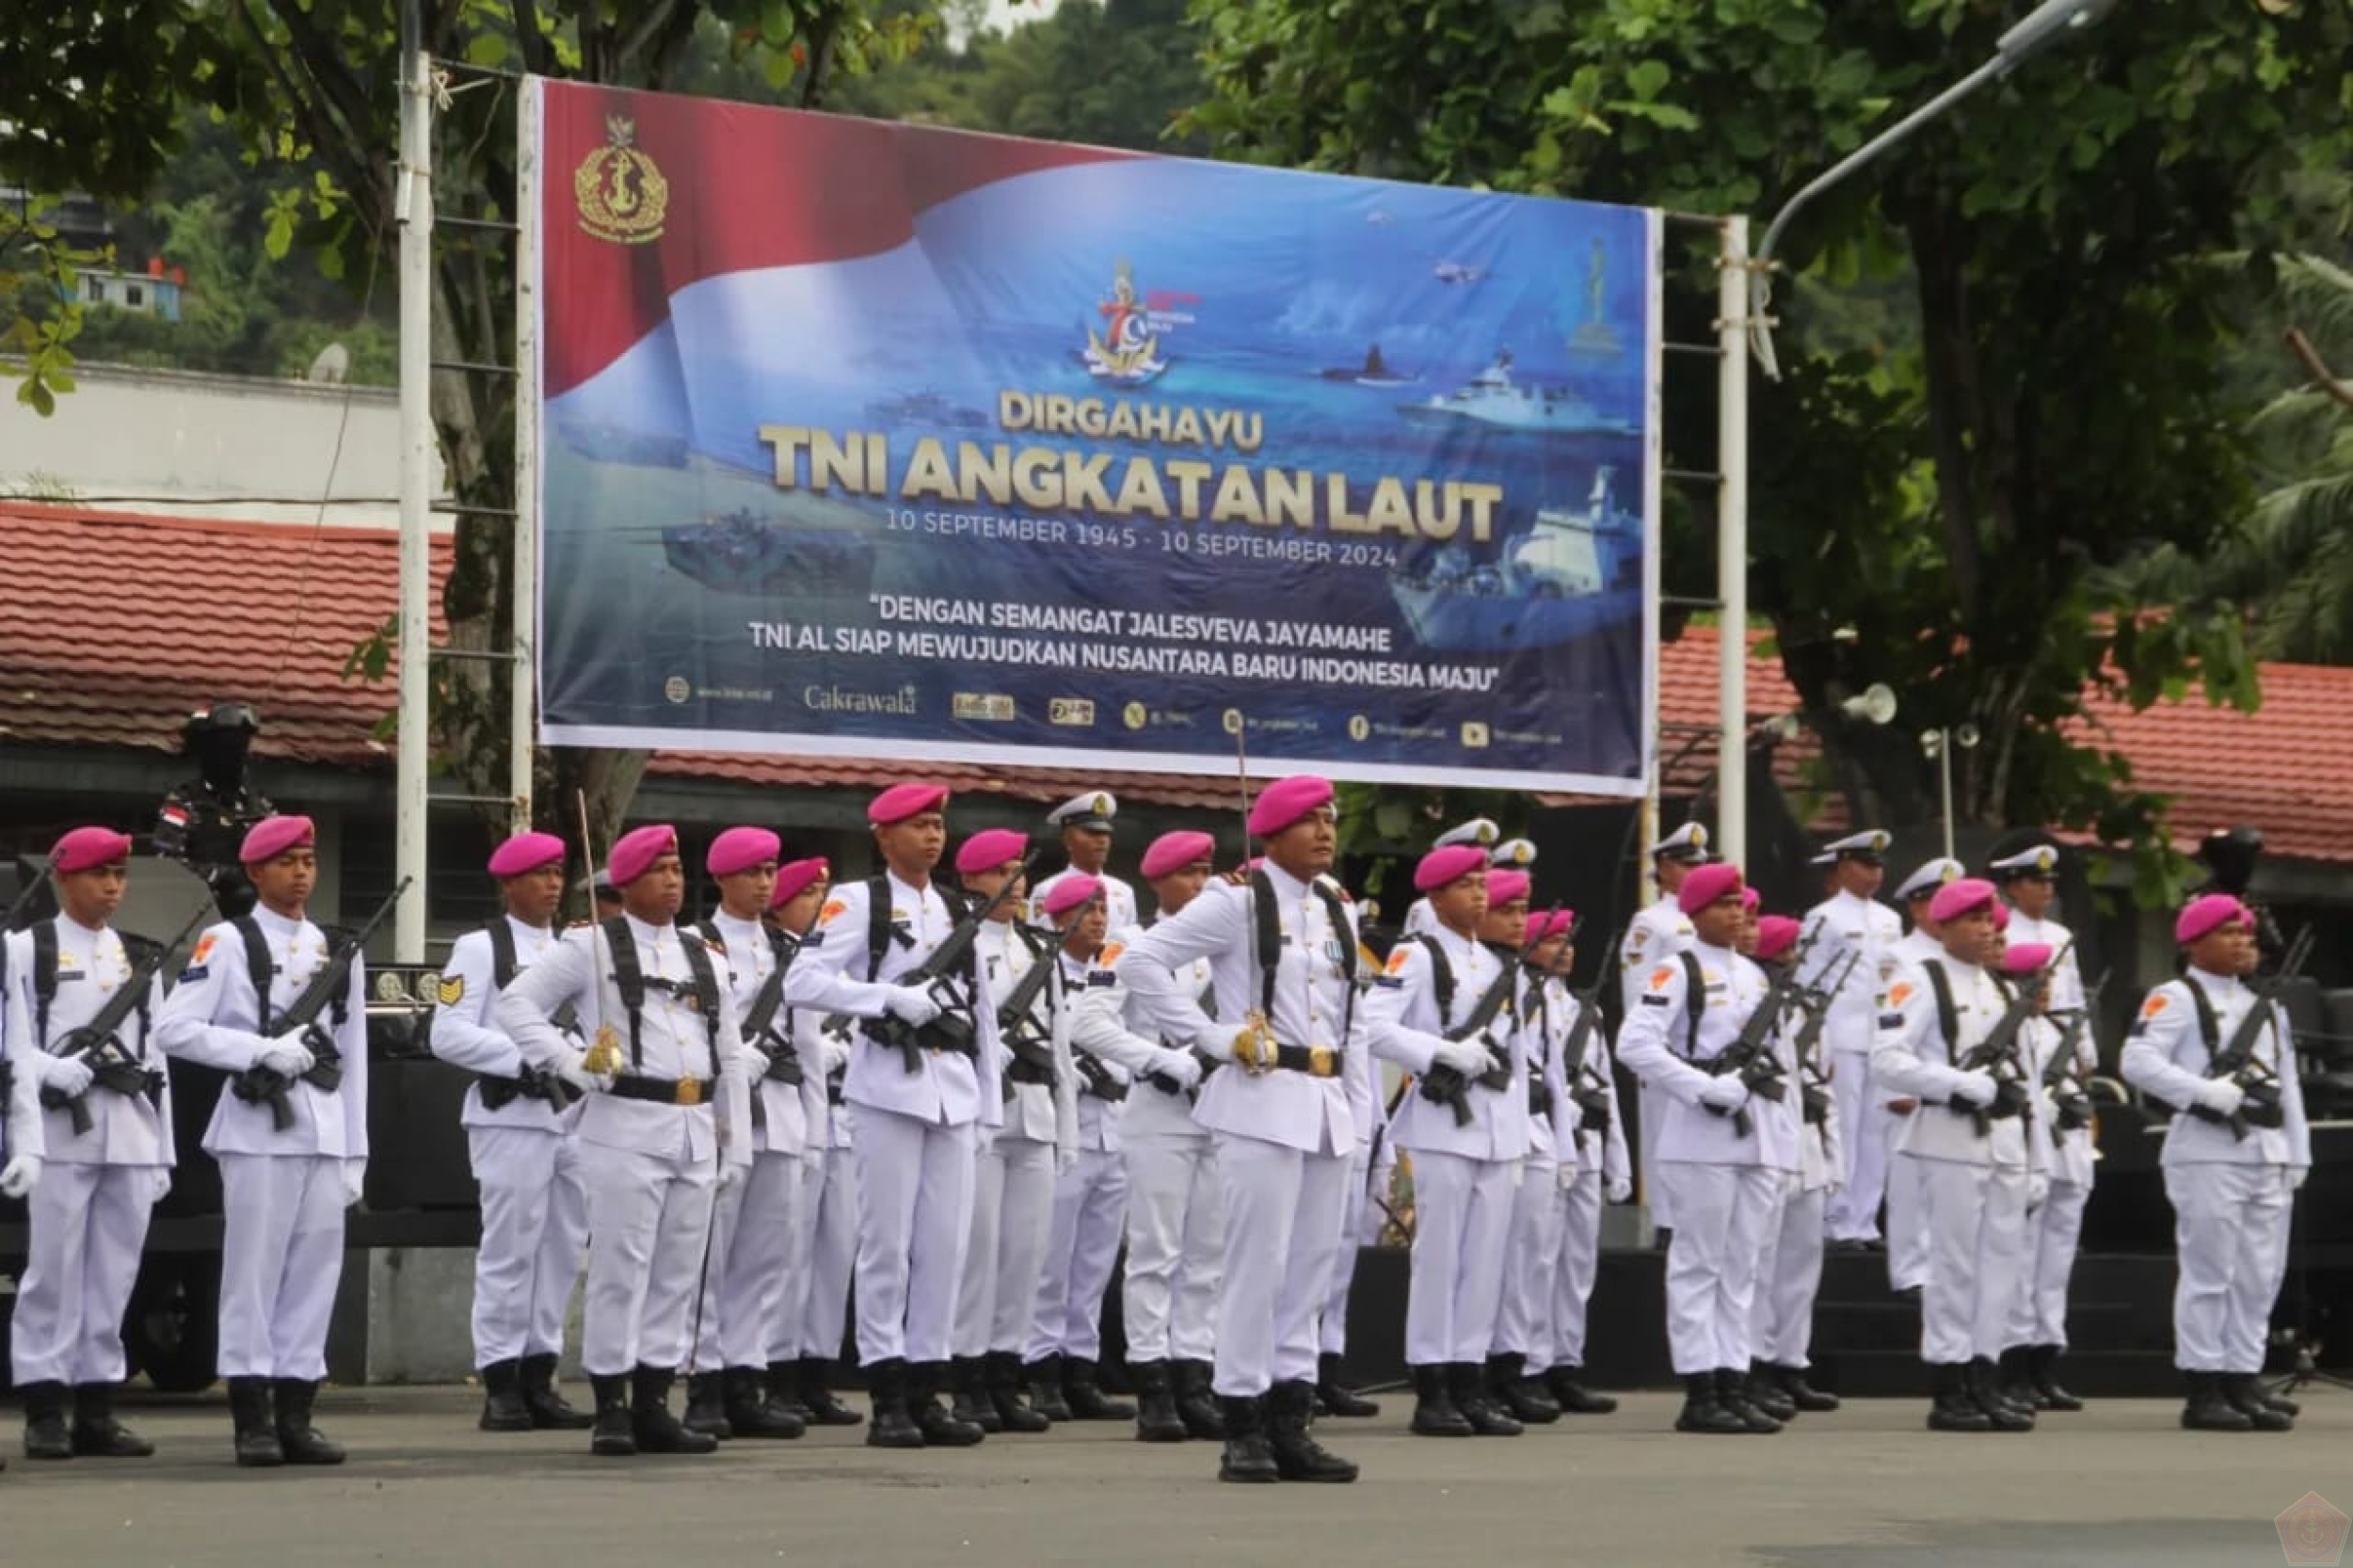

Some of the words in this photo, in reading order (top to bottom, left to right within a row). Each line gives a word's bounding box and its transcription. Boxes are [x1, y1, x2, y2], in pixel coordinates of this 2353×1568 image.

[1000, 391, 1263, 450] DIRGAHAYU
[760, 424, 887, 495] TNI
[902, 437, 1314, 528] ANGKATAN
[1328, 473, 1503, 542] LAUT
[888, 509, 915, 531] 10
[925, 513, 1066, 543] SEPTEMBER
[1078, 526, 1136, 549] 1945
[1161, 532, 1190, 552] 10
[1198, 534, 1332, 562] SEPTEMBER
[1339, 544, 1399, 567] 2024
[749, 623, 792, 648] TNI
[796, 627, 829, 650] AL
[836, 628, 892, 654] SIAP
[898, 633, 1077, 667] MEWUJUDKAN
[1082, 644, 1225, 678] NUSANTARA
[1232, 652, 1296, 680] BARU
[1302, 658, 1424, 688] INDONESIA
[991, 602, 1124, 634] SEMANGAT
[1128, 613, 1260, 644] JALESVEVA
[1265, 621, 1392, 652] JAYAMAHE
[804, 684, 917, 714] Cakrawala
